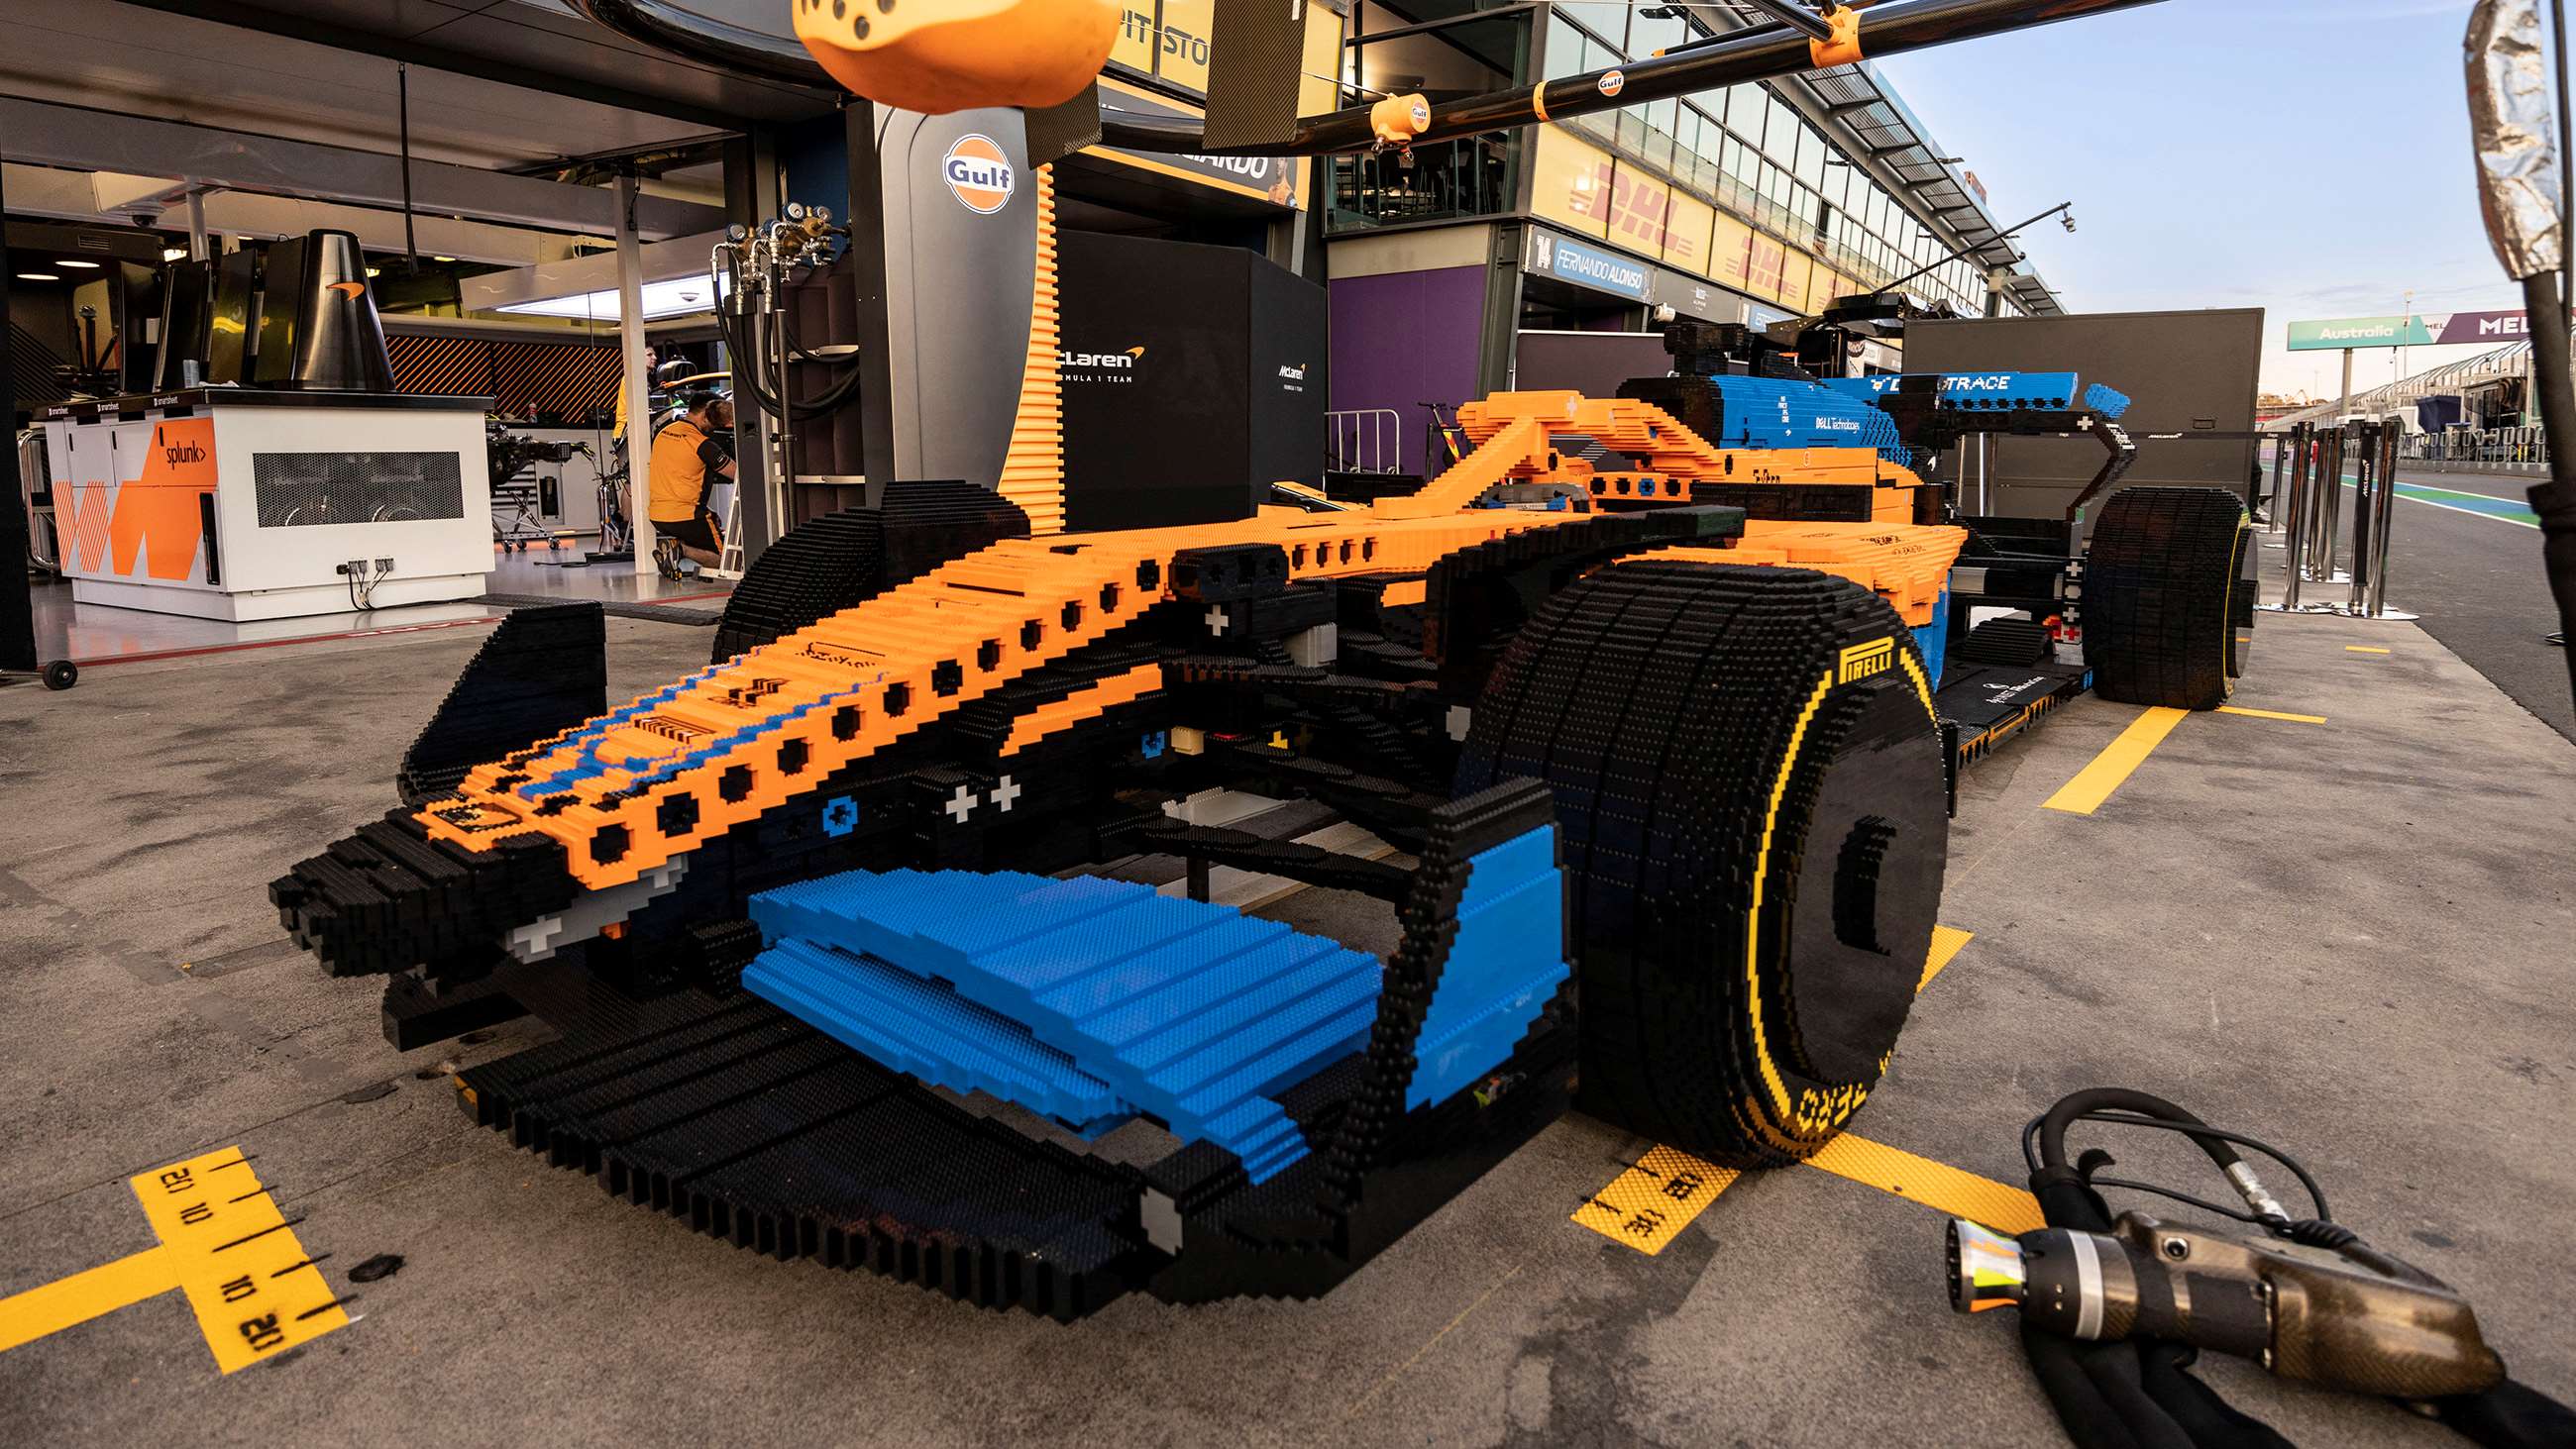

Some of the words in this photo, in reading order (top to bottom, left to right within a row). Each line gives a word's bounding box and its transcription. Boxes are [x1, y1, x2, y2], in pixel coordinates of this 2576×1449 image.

[1121, 8, 1151, 44] IT
[1163, 26, 1208, 66] STO
[1600, 78, 1622, 88] Gulf
[1412, 108, 1427, 118] Gulf
[948, 160, 1010, 188] Gulf
[1588, 162, 1679, 251] DHL
[1537, 235, 1552, 269] 14
[1556, 249, 1609, 279] FERNANDO
[1607, 265, 1643, 289] ALONSO
[2319, 325, 2394, 341] Australia
[2479, 316, 2531, 336] MEL
[1055, 352, 1132, 367] cLaren
[1838, 636, 1895, 685] PIRELLI
[160, 1168, 195, 1194] 20
[179, 1201, 214, 1225] 10
[220, 1275, 257, 1303] 10
[239, 1312, 284, 1353] 20
